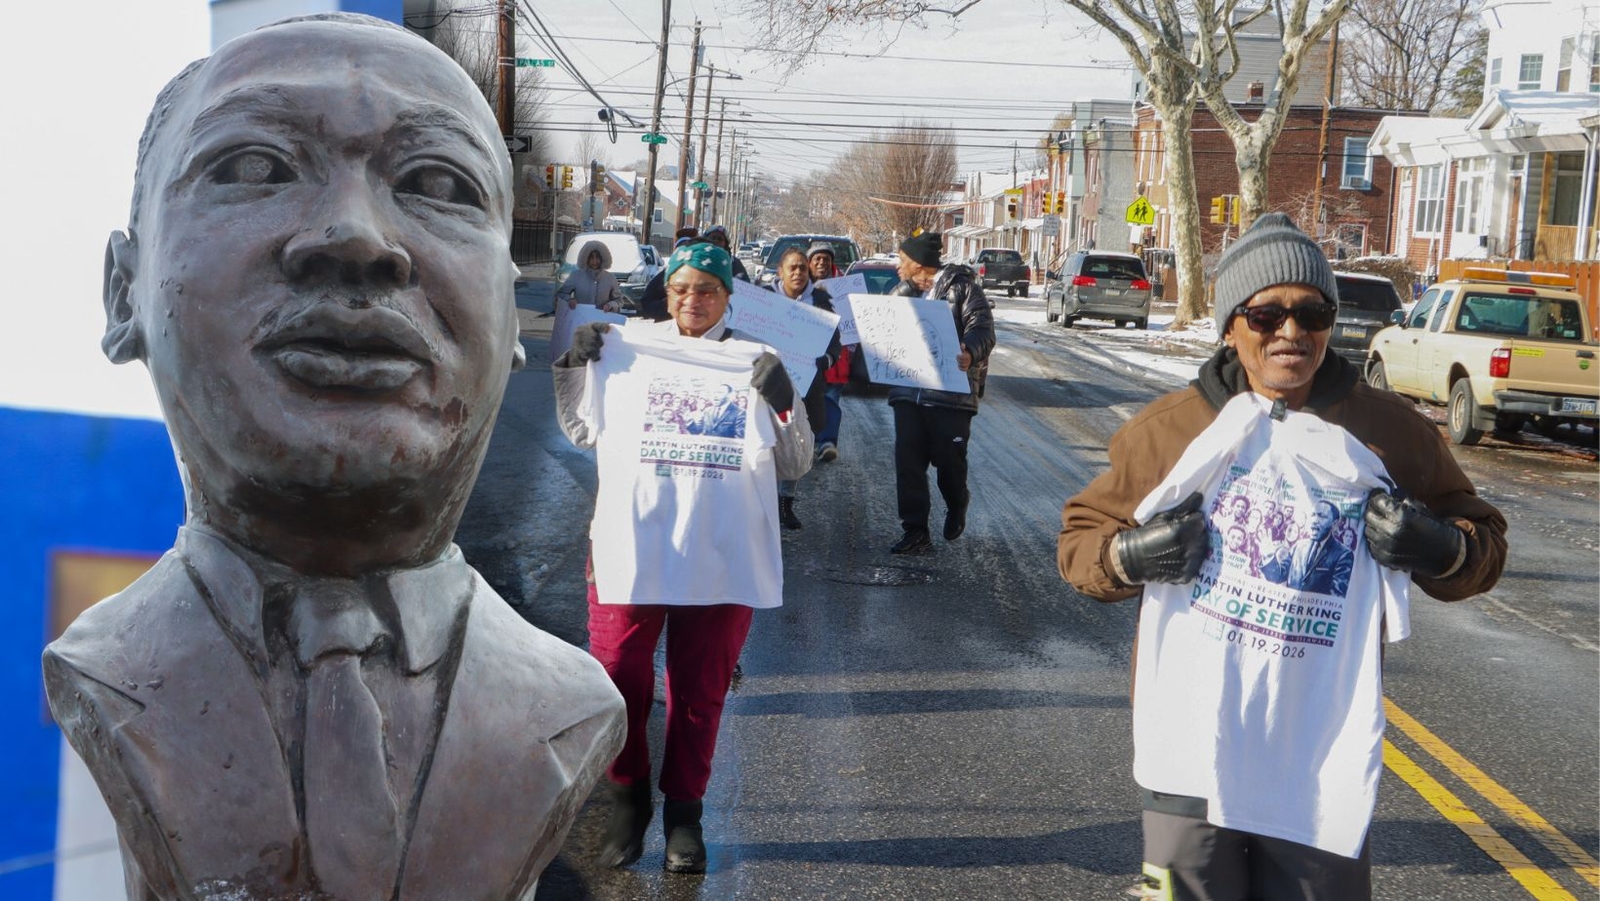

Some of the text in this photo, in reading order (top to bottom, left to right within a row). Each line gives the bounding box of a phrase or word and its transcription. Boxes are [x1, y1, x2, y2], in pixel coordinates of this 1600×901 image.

[640, 448, 667, 458] DAY
[669, 450, 686, 459] OF
[688, 451, 743, 466] SERVICE
[641, 440, 678, 448] MARTIN
[681, 443, 718, 452] LUTHER
[721, 446, 744, 454] KING
[1192, 583, 1339, 639] DAY OF SERVICE
[1195, 572, 1342, 621] MARTIN LUTHER KING
[1227, 629, 1306, 659] 01.19.2026
